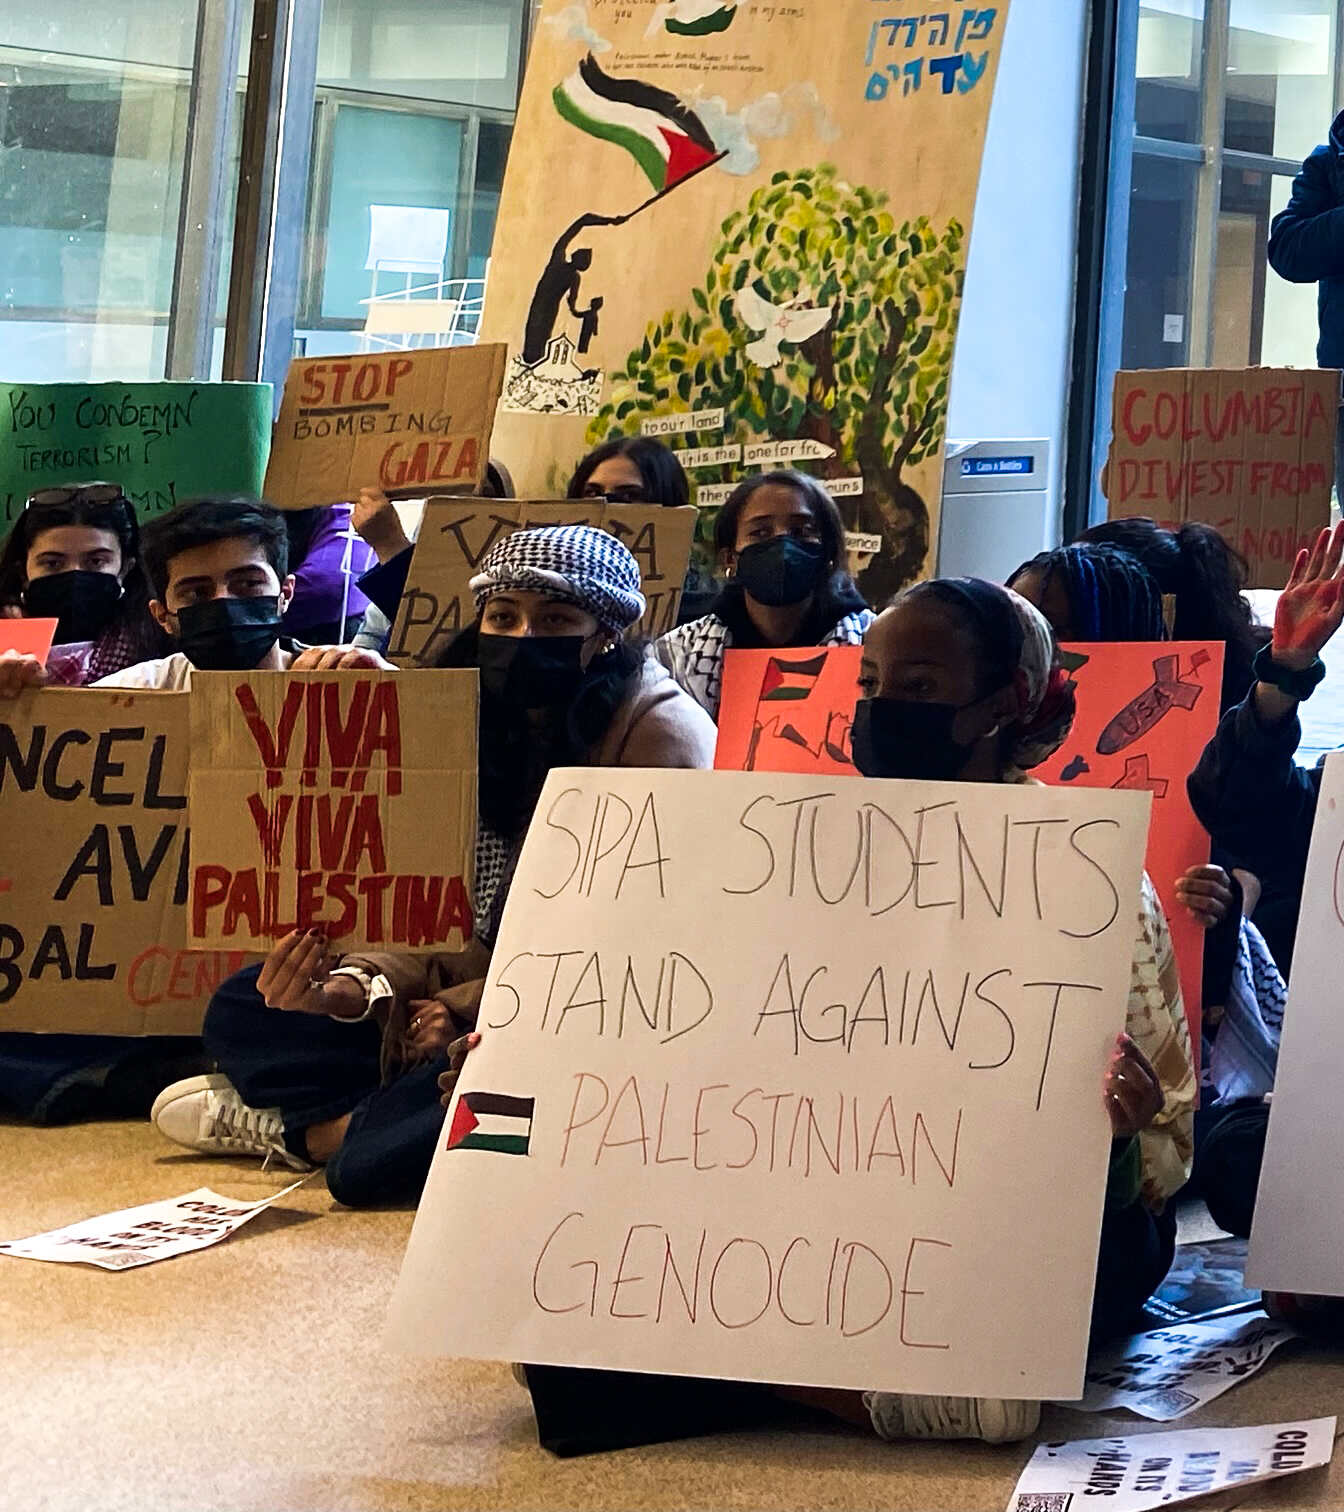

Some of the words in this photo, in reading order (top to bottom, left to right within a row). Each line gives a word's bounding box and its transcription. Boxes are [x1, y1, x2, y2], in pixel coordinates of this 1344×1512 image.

[614, 9, 632, 23] you
[864, 55, 925, 101] הים
[300, 359, 415, 406] STOP
[8, 390, 55, 433] YOU
[76, 389, 199, 433] CONDEMN
[293, 410, 453, 440] BOMBING
[691, 414, 721, 429] land
[1122, 384, 1329, 446] COLUMBIA
[378, 438, 478, 488] GAZA
[715, 449, 737, 461] the
[748, 447, 771, 459] one
[700, 490, 722, 503] the
[1119, 459, 1246, 504] DIVEST
[1250, 459, 1327, 498] FROM
[1119, 688, 1169, 736] USA
[235, 679, 402, 796] VIVA
[248, 792, 386, 874] VIVA
[533, 788, 671, 901] SIPA
[722, 791, 1122, 938] STUDENTS
[192, 865, 474, 948] PALESTINA
[487, 951, 715, 1045] STAND
[754, 953, 1104, 1112] AGAINST
[560, 1072, 962, 1188] PALESTINIAN
[533, 1211, 953, 1350] GENOCIDE
[1083, 1452, 1132, 1496] HANDS
